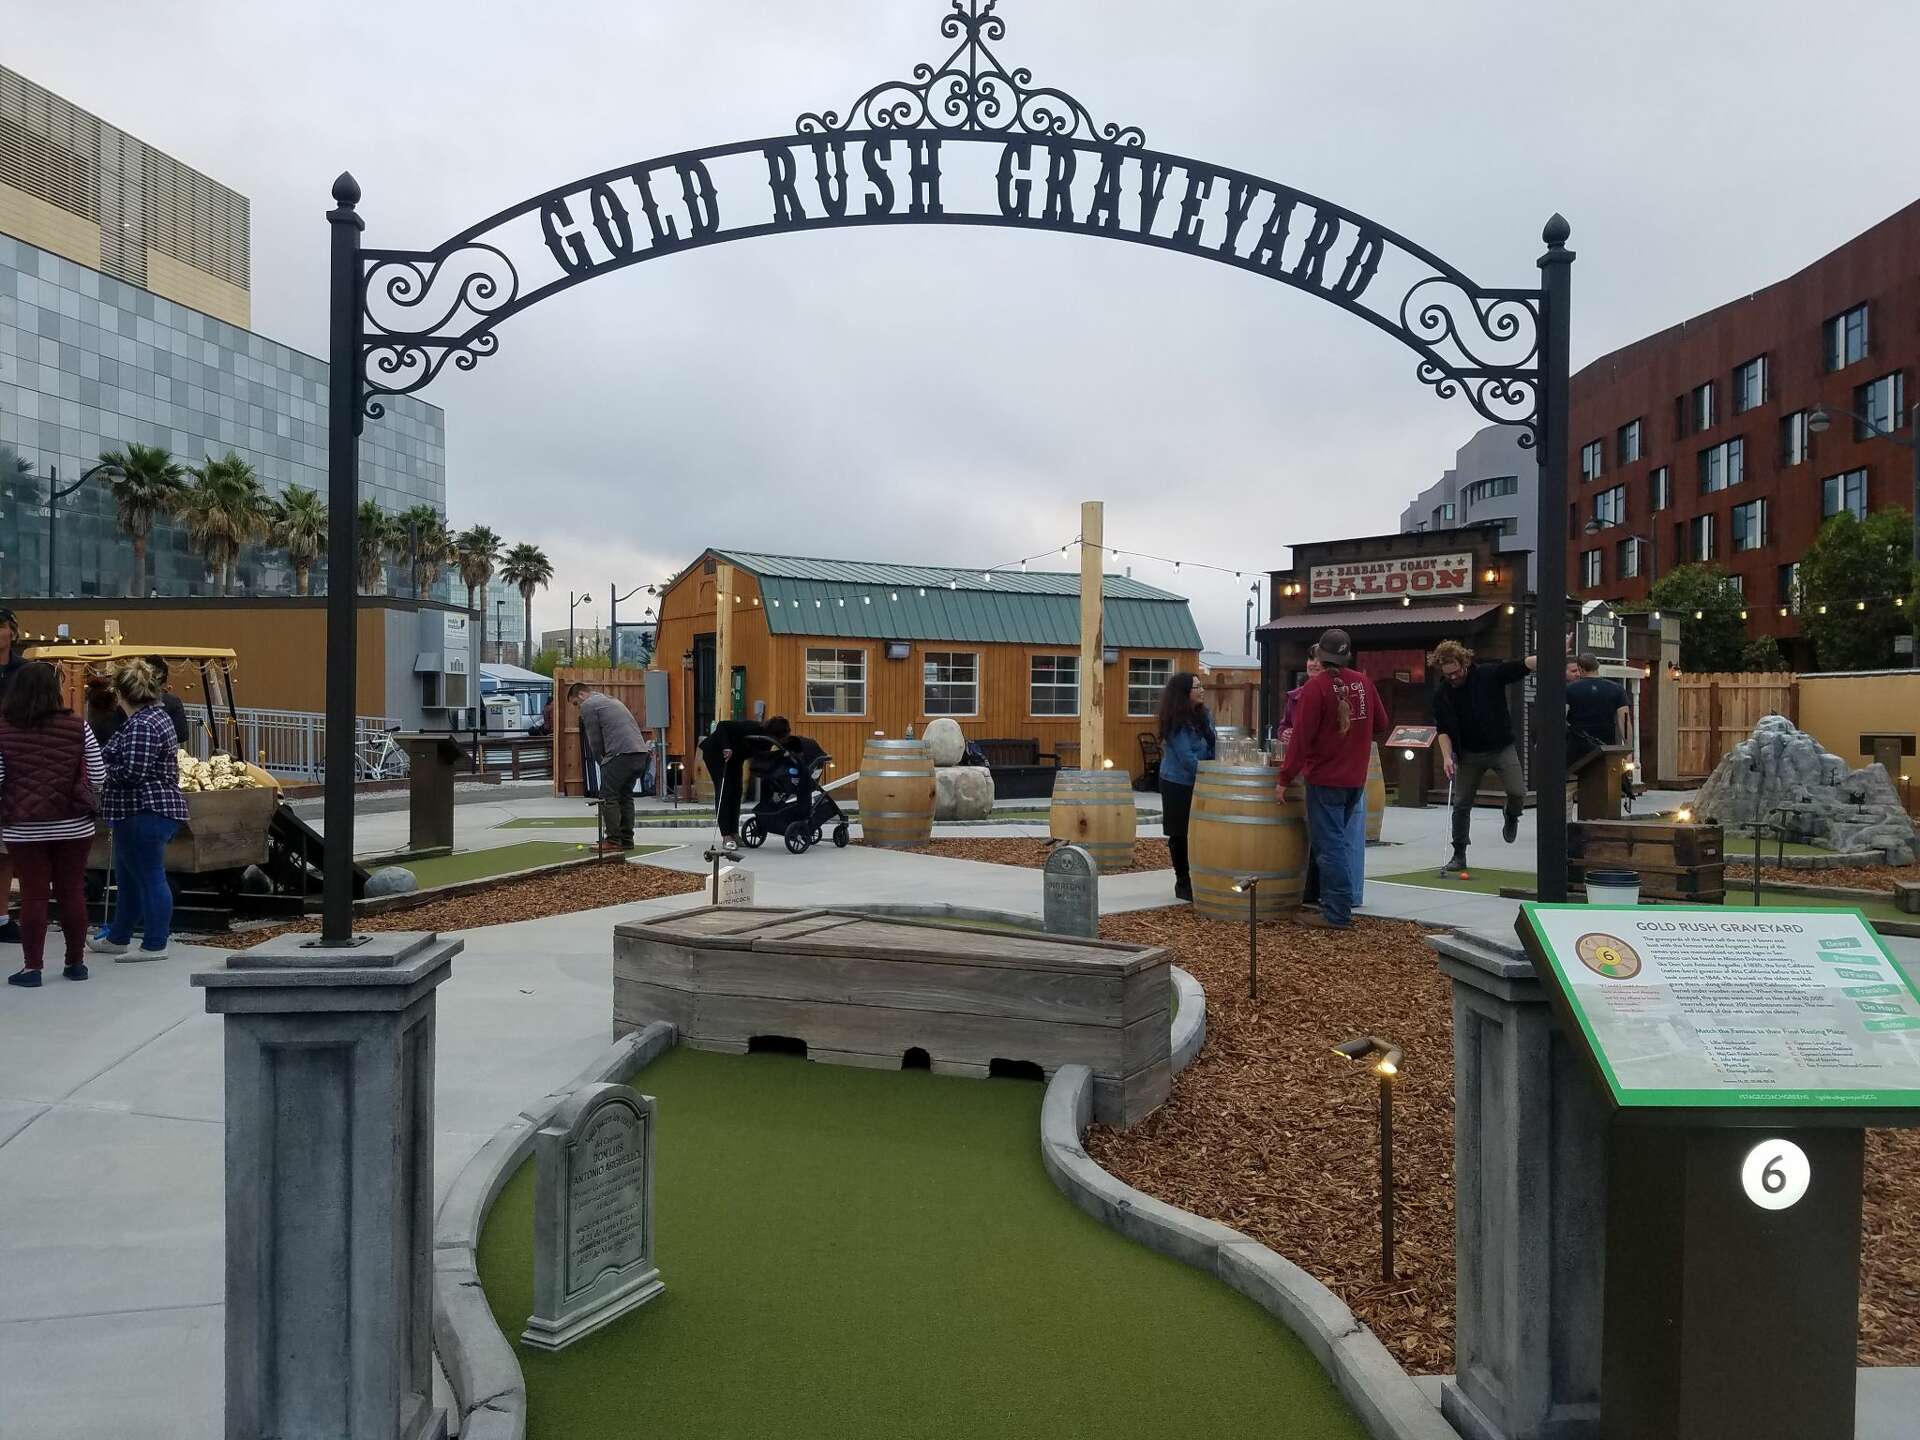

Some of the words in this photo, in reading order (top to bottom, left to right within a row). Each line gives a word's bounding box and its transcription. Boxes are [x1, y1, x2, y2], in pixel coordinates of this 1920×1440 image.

[541, 158, 720, 275] GOLD
[763, 139, 944, 224] RUSH
[995, 142, 1385, 302] GRAVEYARD
[1337, 563, 1394, 577] BARBARY
[1400, 559, 1438, 572] COAST
[1312, 568, 1468, 598] SALOON
[1587, 623, 1615, 648] BANK
[1636, 922, 1676, 932] GOLD
[1679, 922, 1717, 933] RUSH
[1720, 923, 1804, 934] GRAVEYARD
[1603, 951, 1614, 961] 6
[608, 1143, 625, 1157] LUIS
[573, 1165, 604, 1185] ANTONIO
[1761, 1154, 1787, 1194] 6
